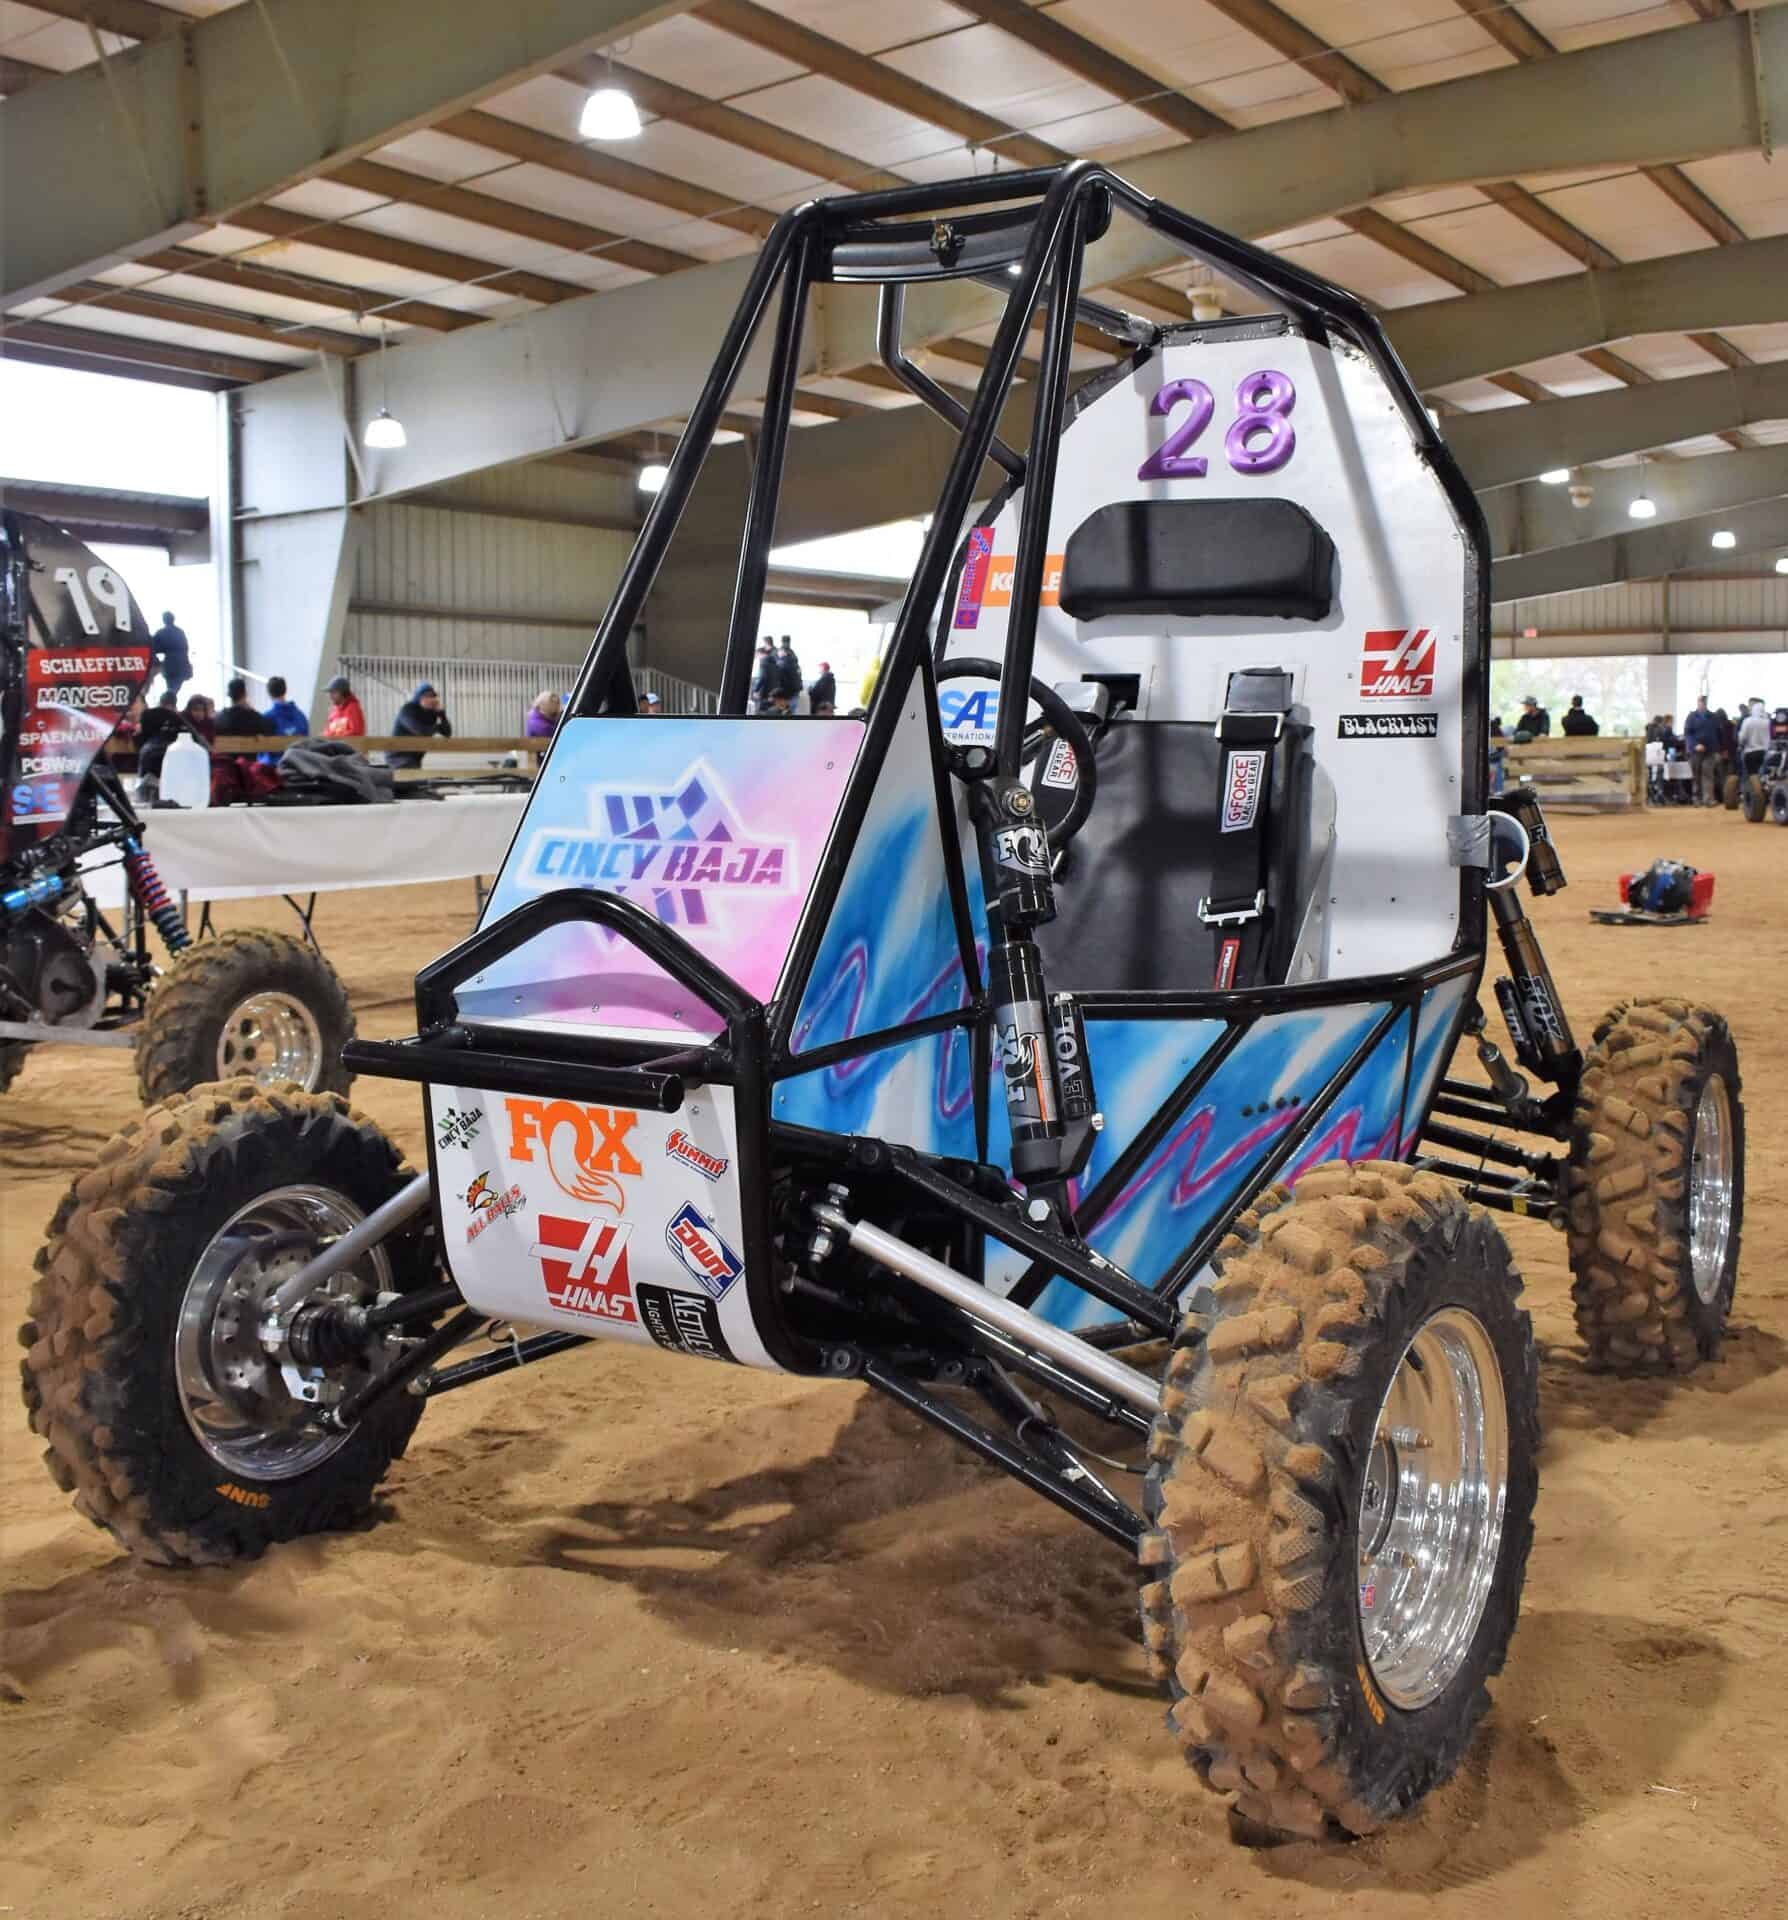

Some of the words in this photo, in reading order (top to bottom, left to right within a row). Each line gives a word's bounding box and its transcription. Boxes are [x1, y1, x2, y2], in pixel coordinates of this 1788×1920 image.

[1138, 370, 1296, 481] 28
[55, 566, 131, 635] 19
[40, 656, 146, 674] SCHAEFFLER
[1364, 675, 1432, 694] HAAS
[940, 690, 999, 729] SAE
[1342, 717, 1437, 735] BLACKLIST
[535, 840, 663, 881] CINCY
[662, 846, 785, 884] BAJA
[997, 827, 1049, 869] FOX
[438, 1126, 461, 1149] CINCY
[459, 1107, 483, 1131] BAJA
[504, 1097, 642, 1208] FOX
[673, 1218, 733, 1278] DWT
[557, 1284, 628, 1317] HAAS
